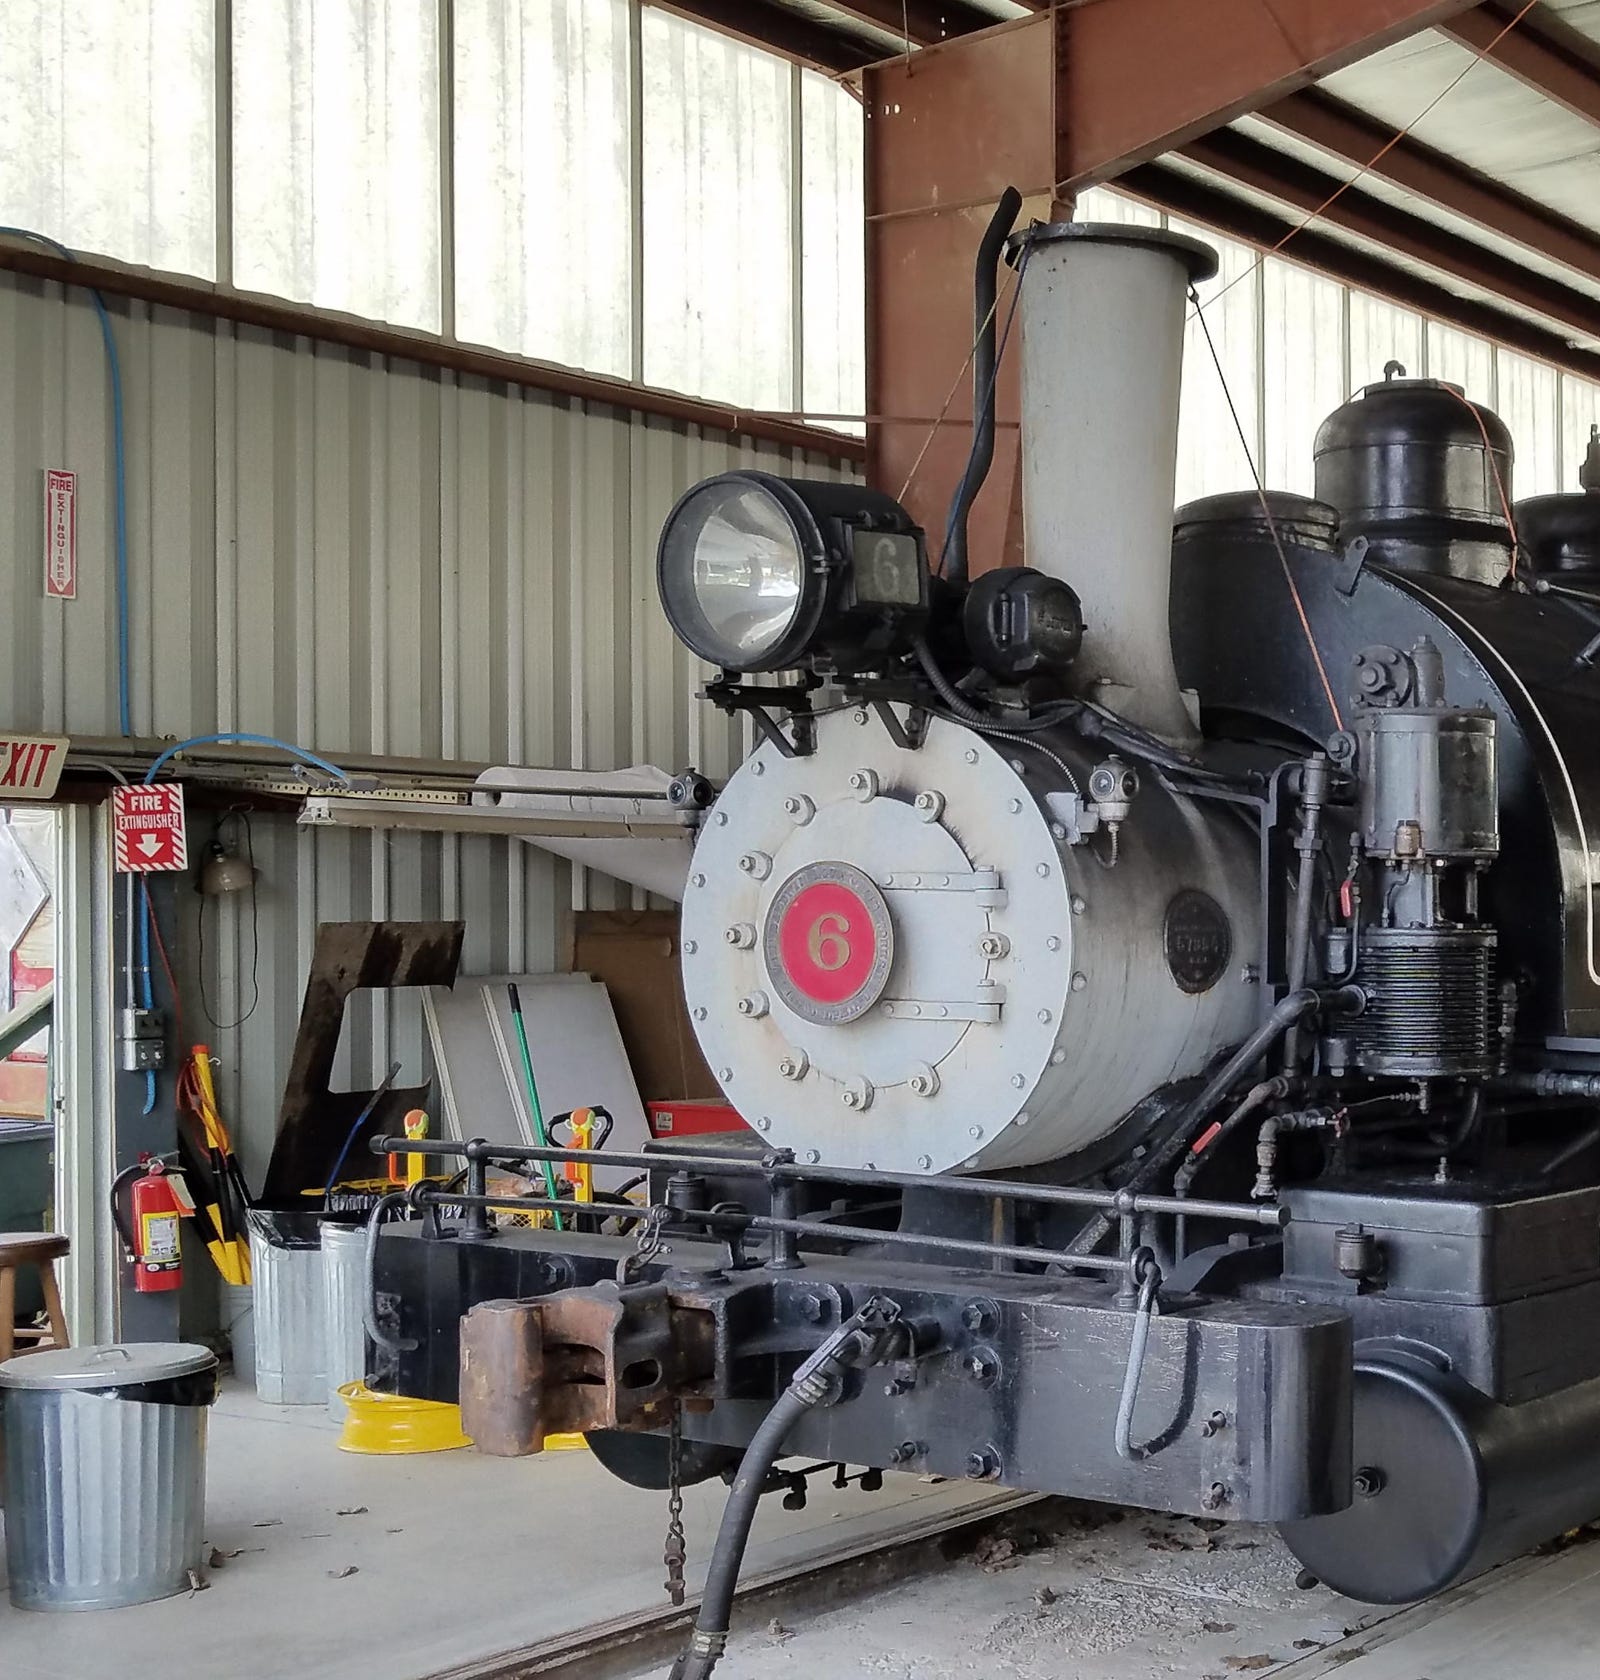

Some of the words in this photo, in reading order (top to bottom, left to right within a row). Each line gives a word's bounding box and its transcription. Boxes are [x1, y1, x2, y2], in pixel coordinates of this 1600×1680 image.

[50, 479, 72, 492] FIRE
[56, 493, 65, 587] EXTINGUISHER
[873, 537, 900, 597] 6
[119, 812, 180, 831] EXTINGUISHER
[130, 795, 164, 812] FIRE
[807, 912, 851, 972] 6
